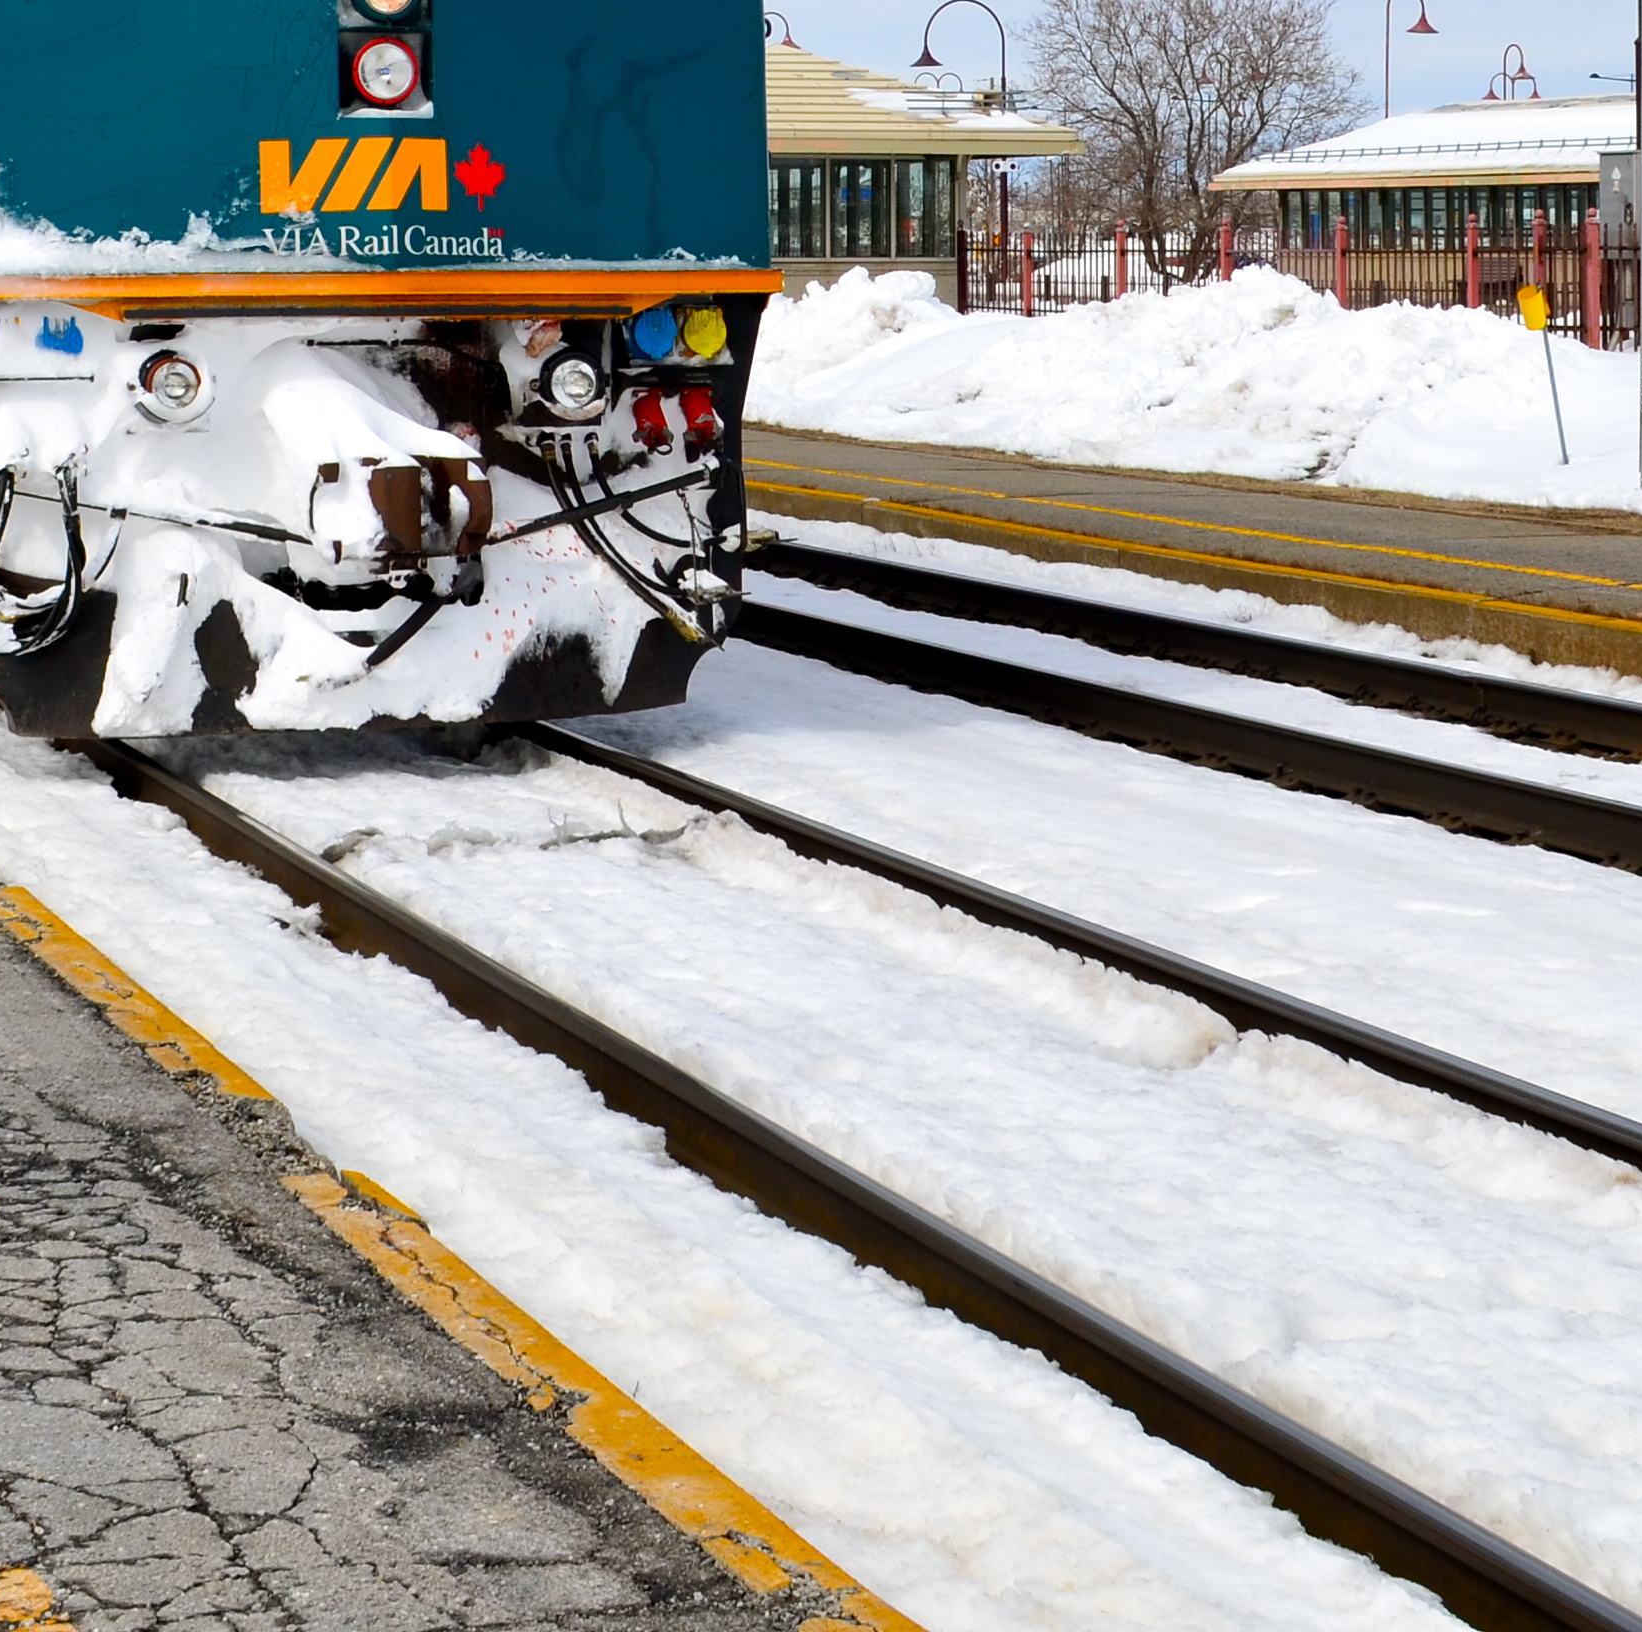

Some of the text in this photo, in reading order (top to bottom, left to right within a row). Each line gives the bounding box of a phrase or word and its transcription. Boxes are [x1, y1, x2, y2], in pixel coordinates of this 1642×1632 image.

[258, 136, 449, 214] VIA
[261, 224, 505, 258] VIA Rail Canada
